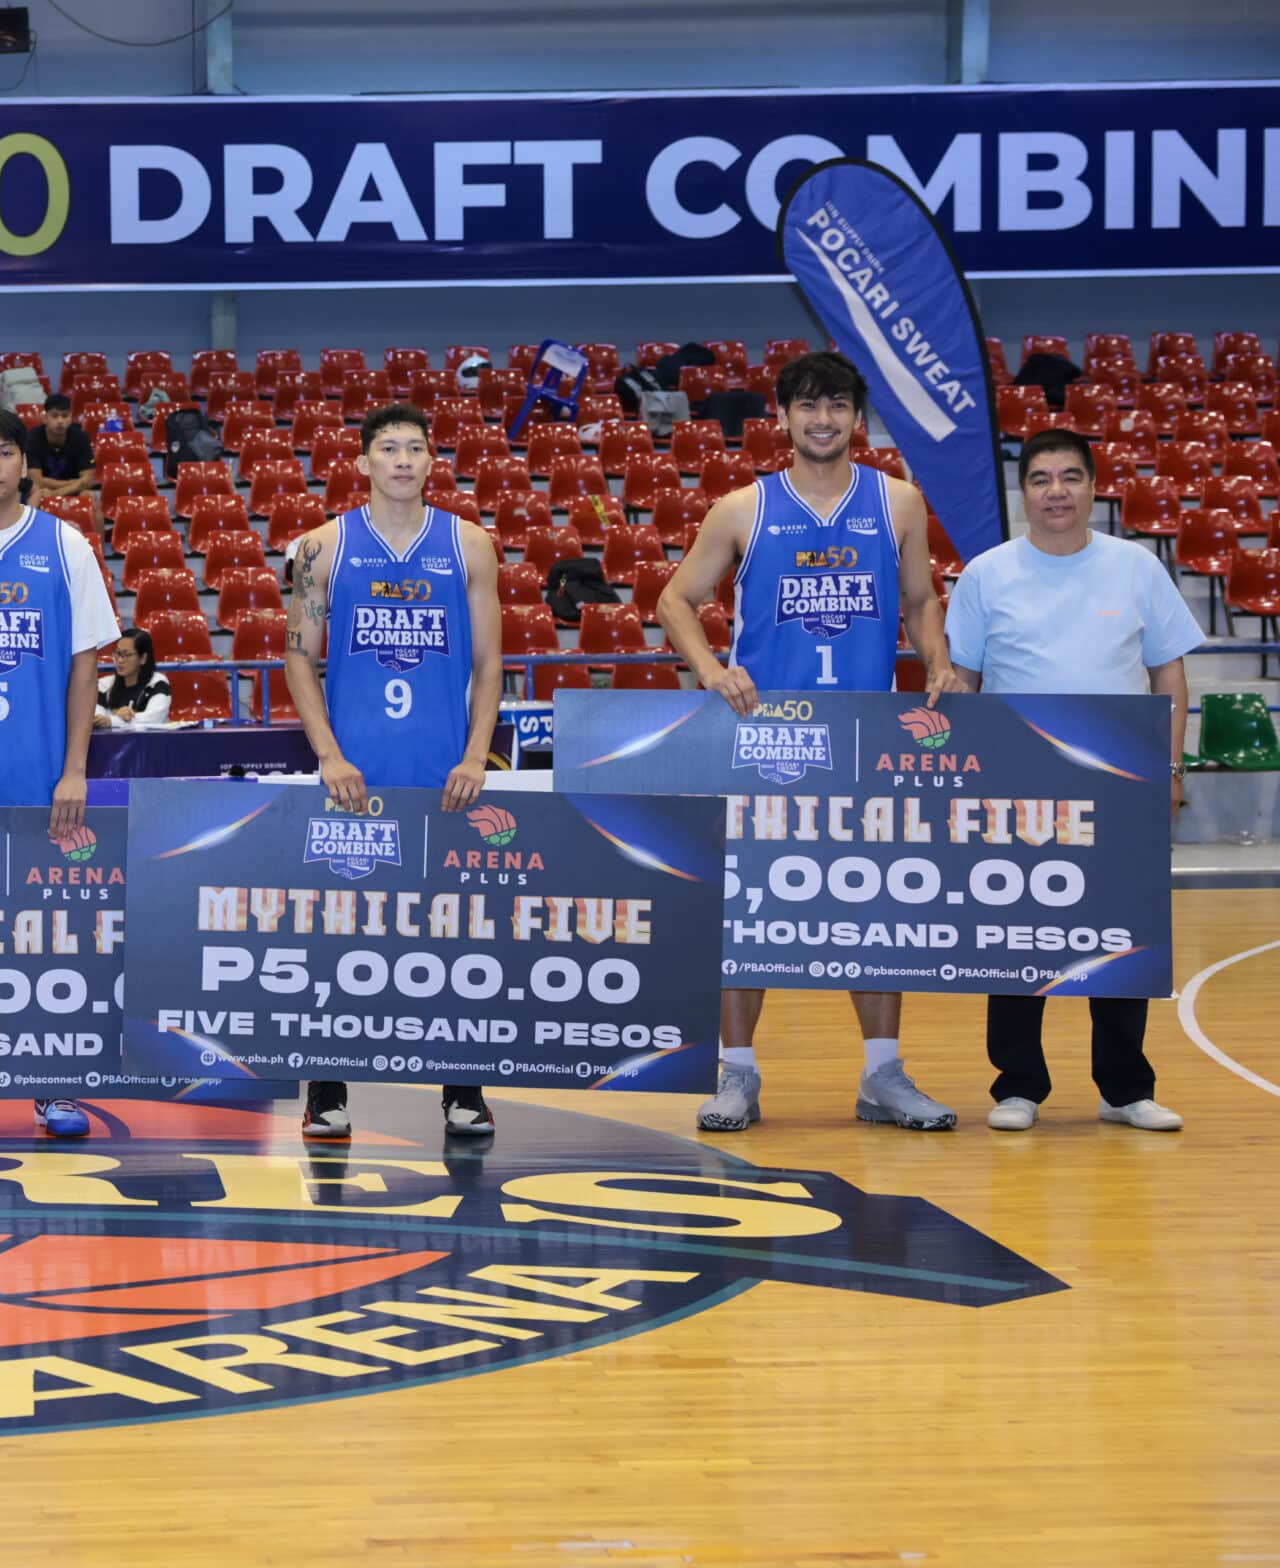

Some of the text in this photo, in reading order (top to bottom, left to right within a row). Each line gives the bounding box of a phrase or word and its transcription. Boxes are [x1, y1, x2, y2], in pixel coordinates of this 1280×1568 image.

[109, 140, 603, 245] DRAFT
[645, 128, 1280, 238] COMBIN
[806, 207, 977, 413] POCARI SWEAT
[782, 575, 872, 599] DRAFT
[782, 597, 873, 614] COMBINE
[356, 608, 444, 630] DRAFT
[356, 630, 445, 646] COMBINE
[816, 645, 838, 684] 1
[384, 679, 412, 720] 9
[739, 727, 825, 746] DRAFT
[740, 746, 826, 760] COMBINE
[875, 754, 981, 772] ARENA
[894, 775, 964, 787] PLUS
[311, 821, 395, 841] DRAFT
[947, 798, 1095, 846] FIVE
[311, 841, 395, 856] COMBINE
[443, 850, 544, 871] ARENA
[26, 867, 125, 884] ARENA
[461, 872, 527, 885] PLUS
[43, 888, 109, 900] PLUS
[198, 886, 652, 944] MYTHICAL FIVE
[723, 921, 1133, 952] HOUSAND PESOS
[201, 946, 640, 1007] P5,000.00
[739, 962, 804, 974] /PBAOfficial
[864, 965, 936, 977] @pbaconnect
[958, 968, 1019, 979] PBAOfficial
[1040, 970, 1060, 979] PBA
[158, 1010, 682, 1048] FIVE THOUSAND PESOS
[305, 1055, 368, 1067] /PBAOfficial
[426, 1060, 495, 1071] @pbaconnect
[516, 1063, 573, 1074] PBAOfficial
[593, 1066, 613, 1075] PBA
[14, 1073, 82, 1085] @pbaconnect
